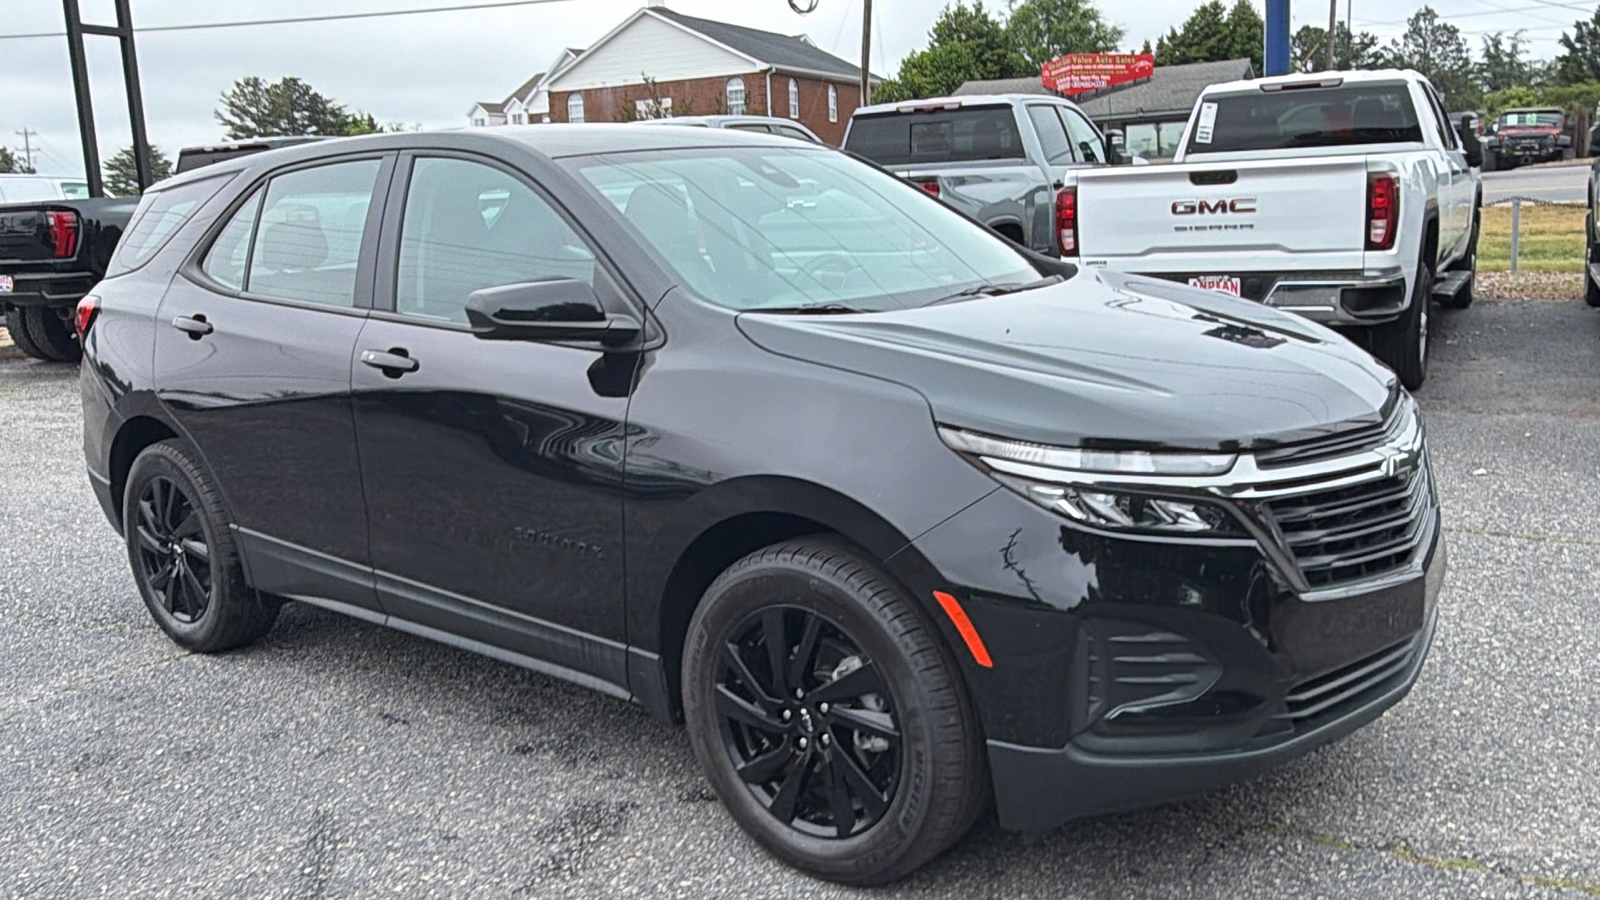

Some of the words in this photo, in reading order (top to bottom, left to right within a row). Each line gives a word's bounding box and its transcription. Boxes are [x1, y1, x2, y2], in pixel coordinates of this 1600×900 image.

[1072, 56, 1092, 64] Value
[1096, 56, 1112, 64] Auto
[1115, 56, 1135, 64] Sales
[1171, 197, 1257, 216] GMC
[1174, 223, 1254, 232] SIERRA
